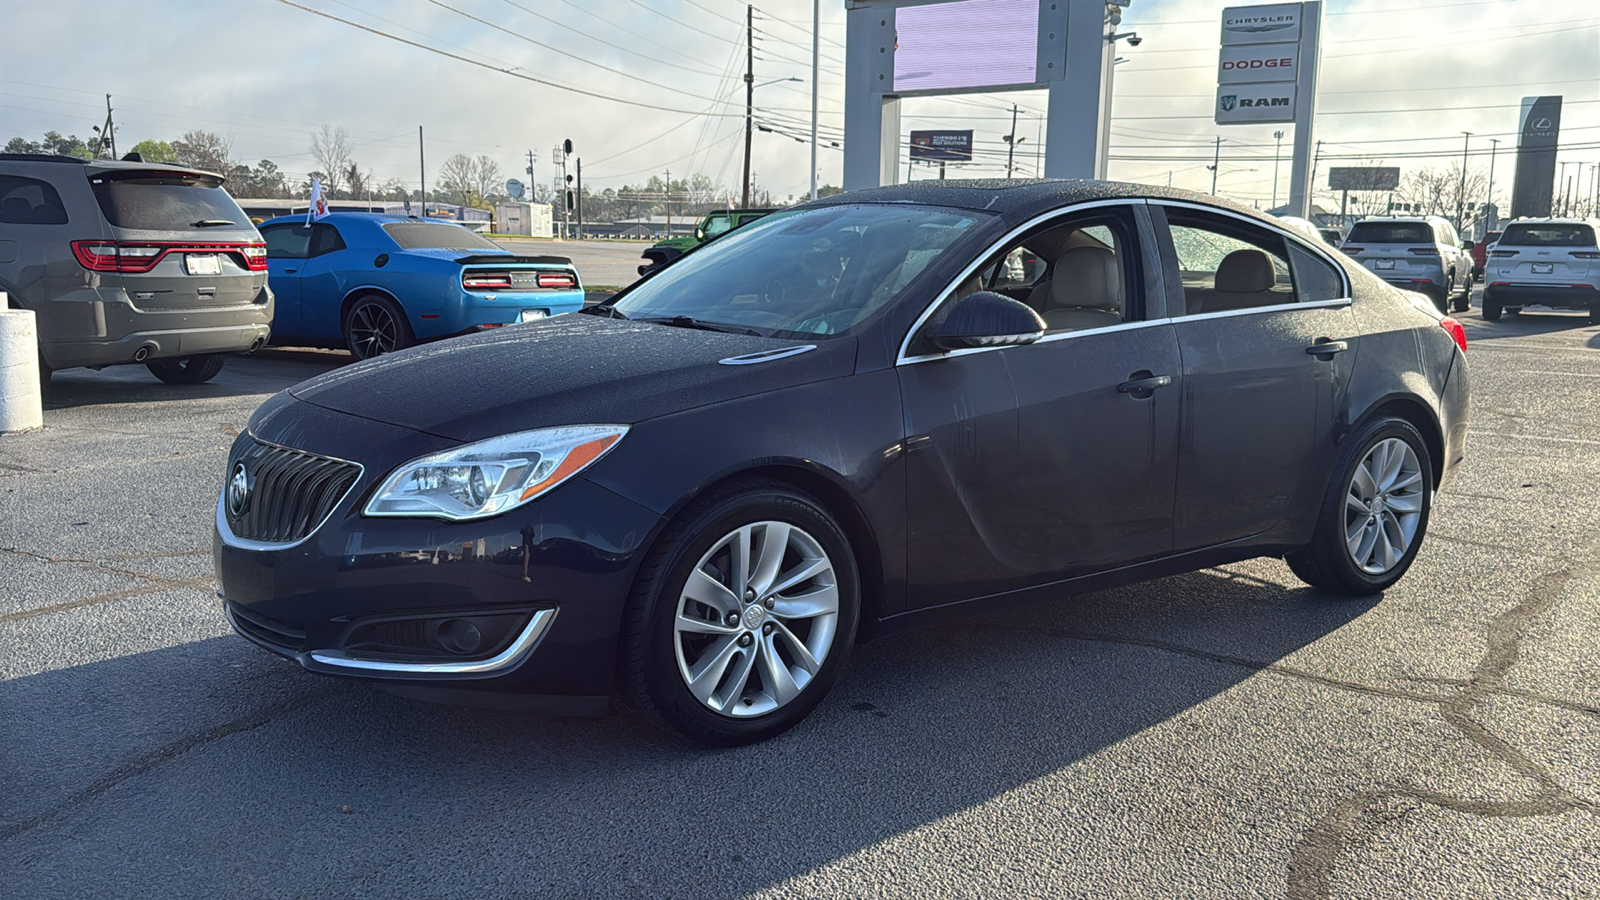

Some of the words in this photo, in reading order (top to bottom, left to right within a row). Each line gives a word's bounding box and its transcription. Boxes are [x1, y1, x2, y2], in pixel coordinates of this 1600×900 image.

[1226, 15, 1294, 25] CHRYSLER
[1222, 58, 1293, 70] DODGE
[1239, 97, 1290, 108] RAM
